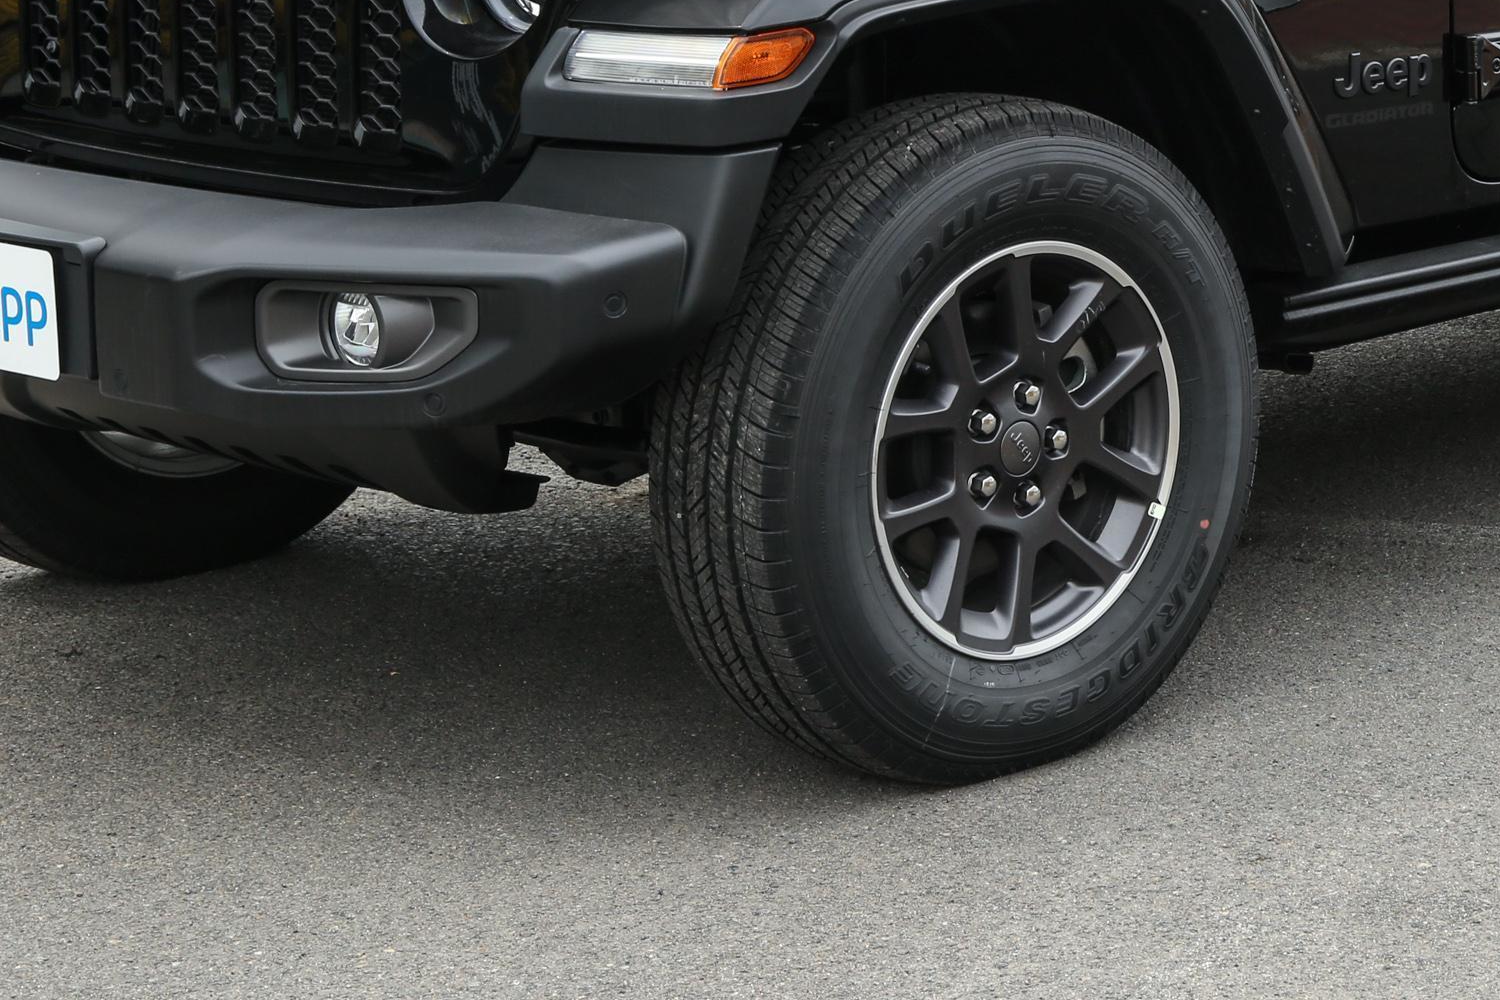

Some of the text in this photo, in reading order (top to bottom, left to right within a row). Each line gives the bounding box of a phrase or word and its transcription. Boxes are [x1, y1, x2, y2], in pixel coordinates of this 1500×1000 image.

[1325, 102, 1435, 129] GLADIATOR
[1333, 51, 1433, 99] Jeep
[898, 171, 1149, 298] DUELER
[889, 542, 1210, 728] BRIDGESTONE
